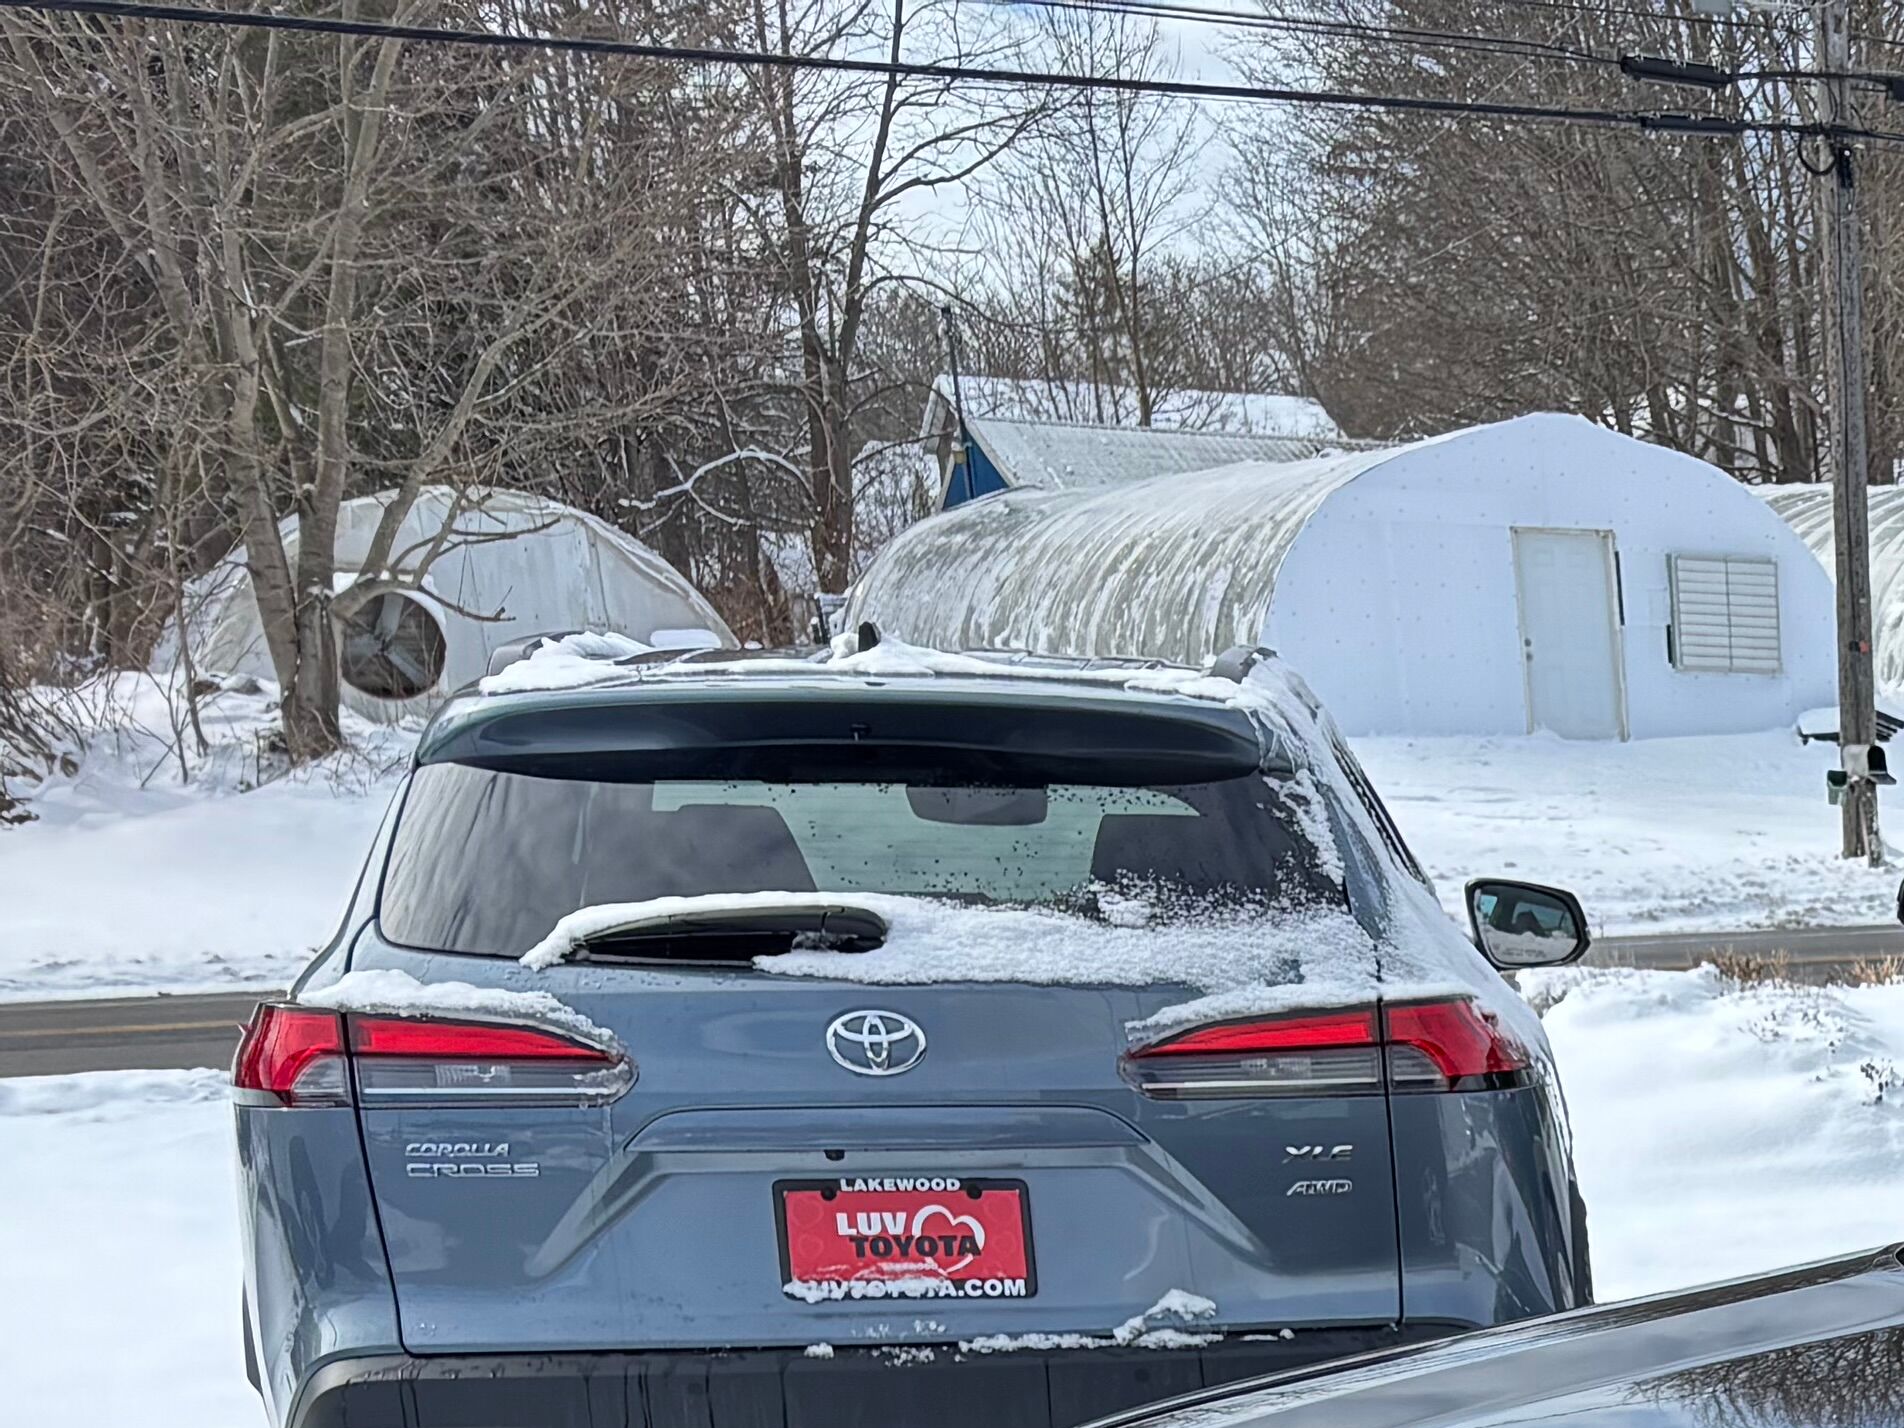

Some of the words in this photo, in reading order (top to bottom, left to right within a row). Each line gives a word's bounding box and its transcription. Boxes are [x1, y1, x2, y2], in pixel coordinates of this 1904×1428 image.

[405, 1142, 511, 1157] COROLLA
[405, 1162, 541, 1178] CROSS
[839, 1177, 961, 1193] LAKEWOOD
[836, 1212, 907, 1236] LUV
[849, 1235, 982, 1258] TOYOTA
